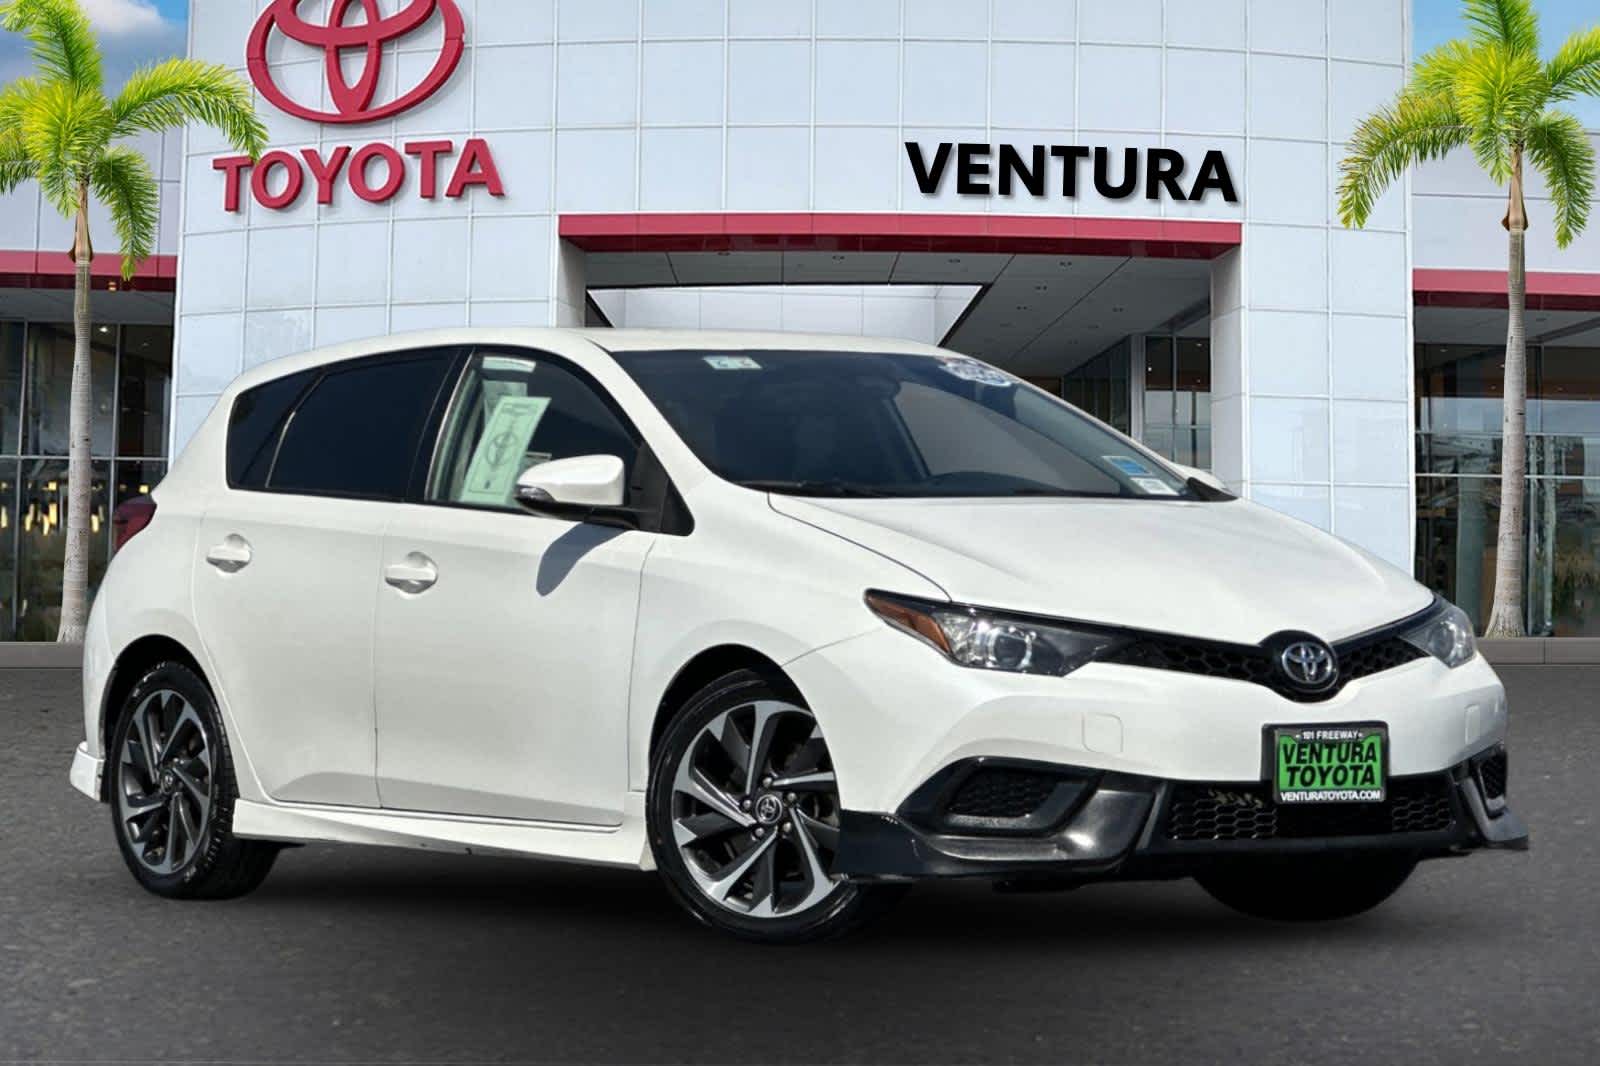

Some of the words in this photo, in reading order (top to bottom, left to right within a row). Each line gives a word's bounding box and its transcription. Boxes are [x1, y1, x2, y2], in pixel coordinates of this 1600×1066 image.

[213, 138, 505, 212] TOYOTA
[904, 141, 1238, 203] VENTURA
[1302, 731, 1315, 740] 101
[1316, 730, 1358, 740] FREEWAY
[1282, 742, 1377, 764] VENTURA
[1286, 765, 1375, 787] TOYOTA
[1280, 790, 1381, 802] VENTURATOYOTA.COM
